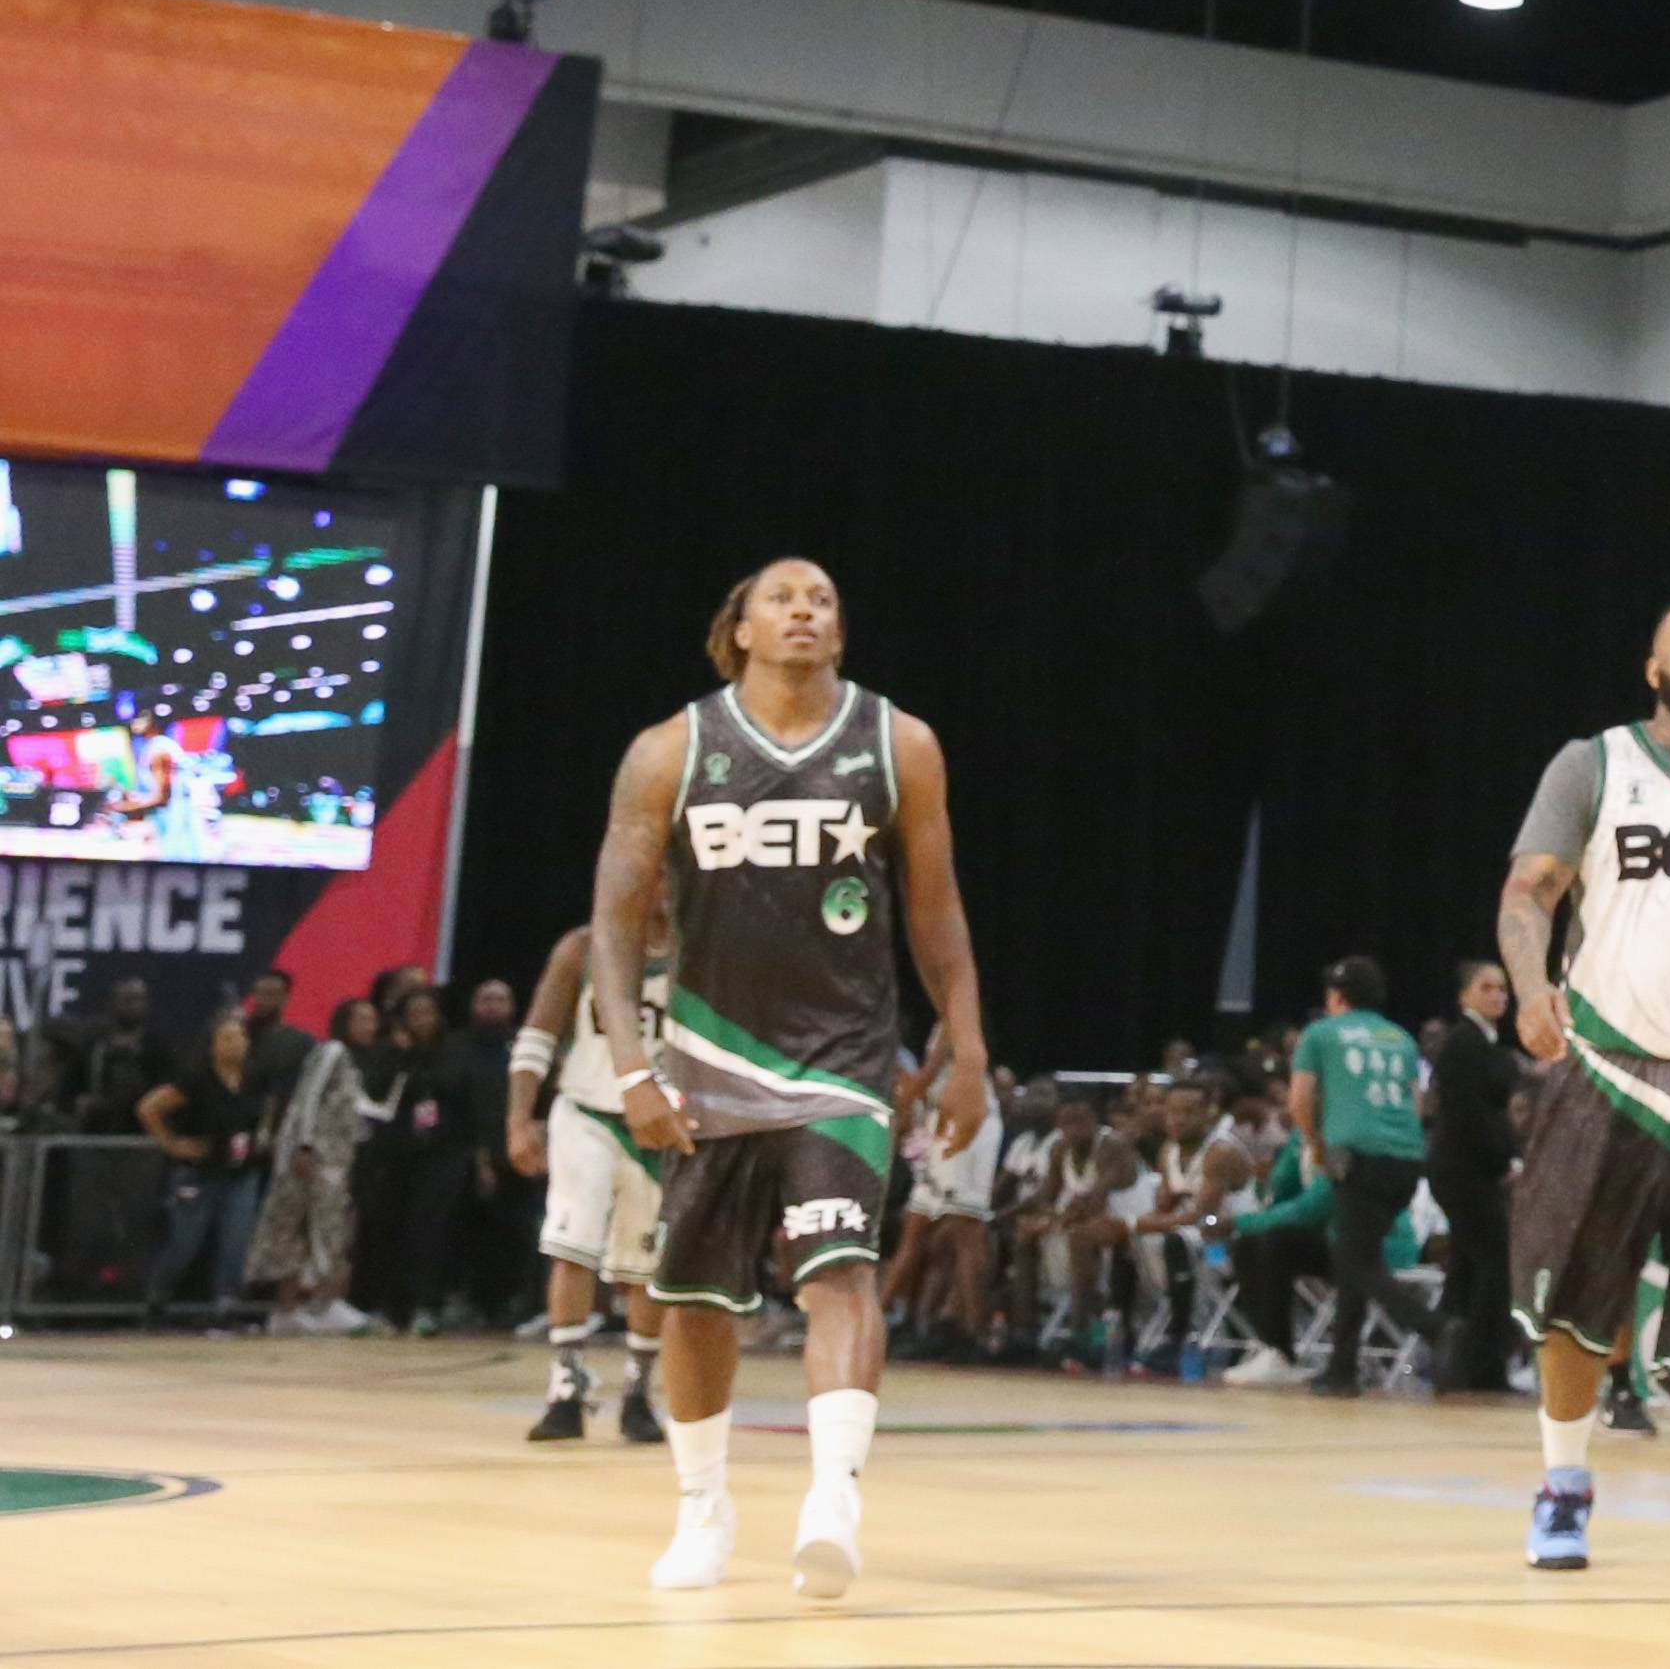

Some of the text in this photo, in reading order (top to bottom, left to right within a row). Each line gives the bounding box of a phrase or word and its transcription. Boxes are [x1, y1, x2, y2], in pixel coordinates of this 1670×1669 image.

[686, 799, 850, 870] BET
[0, 860, 250, 954] IENCE
[820, 876, 869, 935] 6
